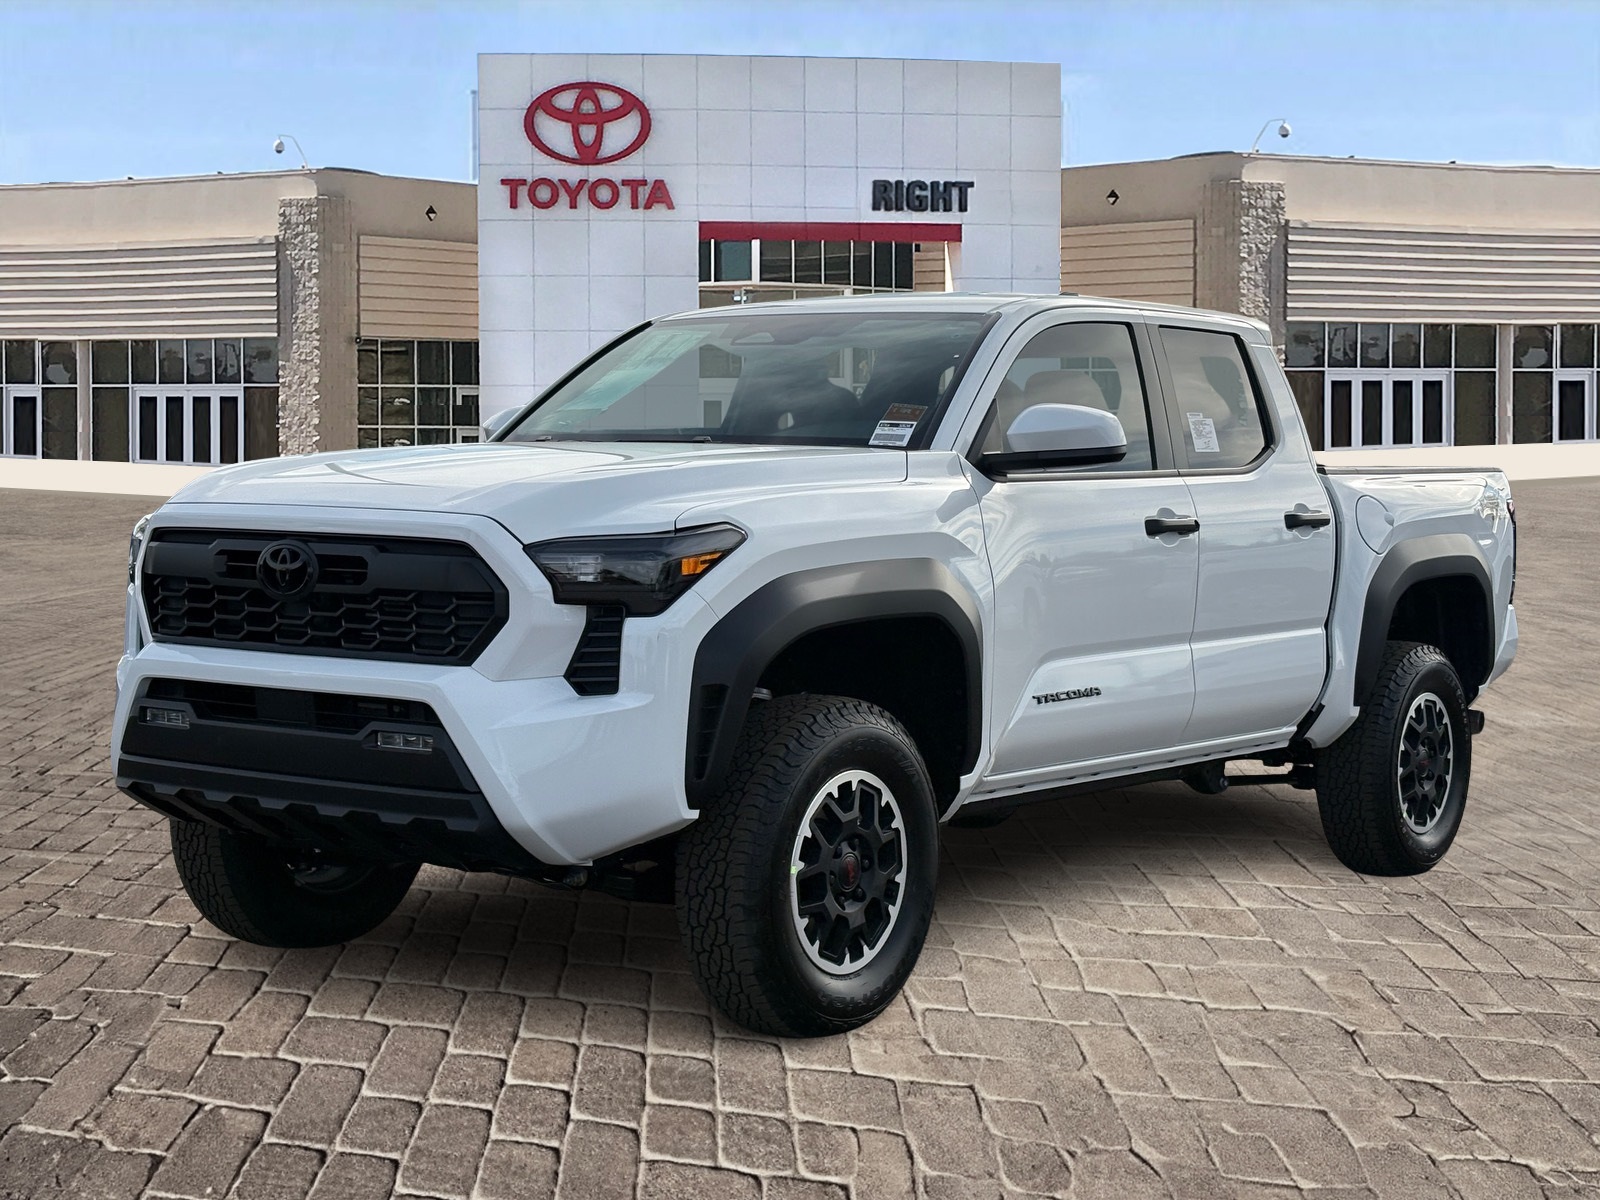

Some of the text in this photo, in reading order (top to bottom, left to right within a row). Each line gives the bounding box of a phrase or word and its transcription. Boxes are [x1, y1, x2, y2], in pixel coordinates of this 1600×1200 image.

[500, 178, 675, 210] TOYOTA
[871, 179, 975, 213] RIGHT
[1032, 686, 1102, 705] TACOMA
